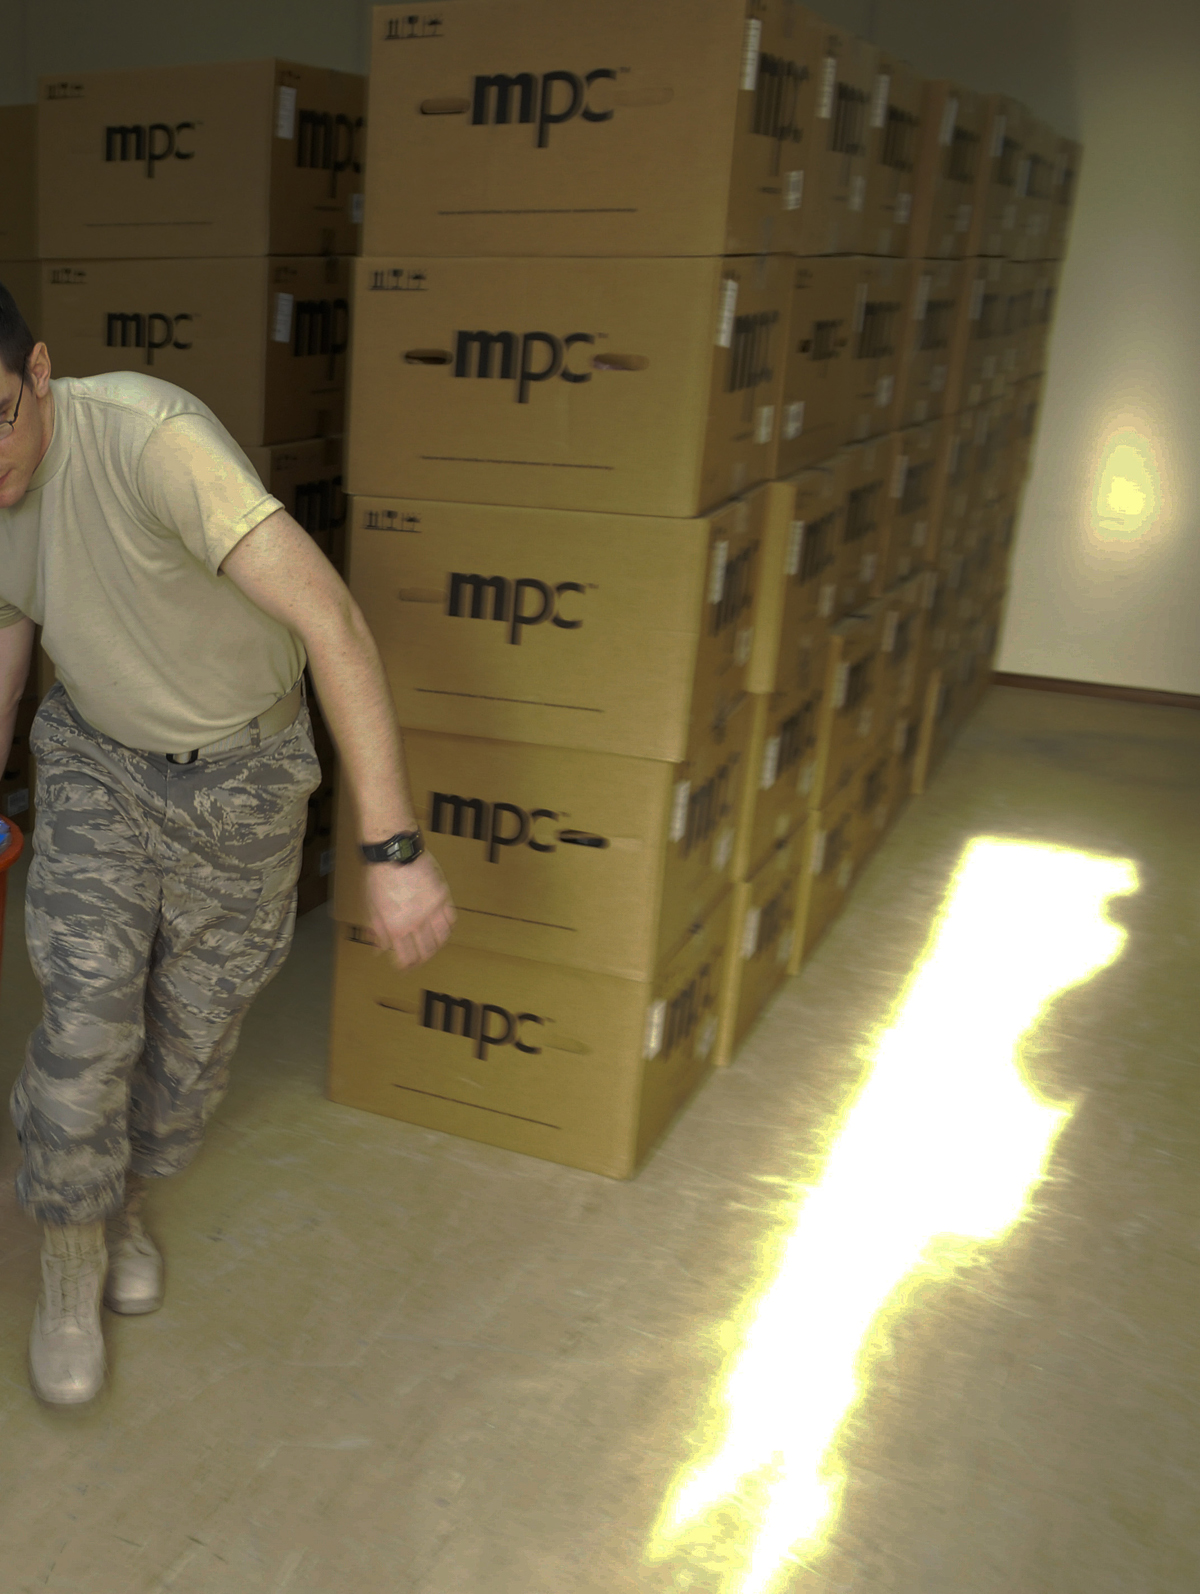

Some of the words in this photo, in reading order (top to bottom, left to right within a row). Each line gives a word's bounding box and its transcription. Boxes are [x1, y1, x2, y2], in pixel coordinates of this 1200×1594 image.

[471, 68, 617, 148] mpc
[105, 121, 197, 178] mpc
[106, 312, 194, 366] mpc
[294, 298, 348, 381] mp
[454, 330, 594, 404] mpc
[446, 571, 586, 645] mpc
[429, 790, 559, 864] mpc
[419, 988, 543, 1060] mpc
